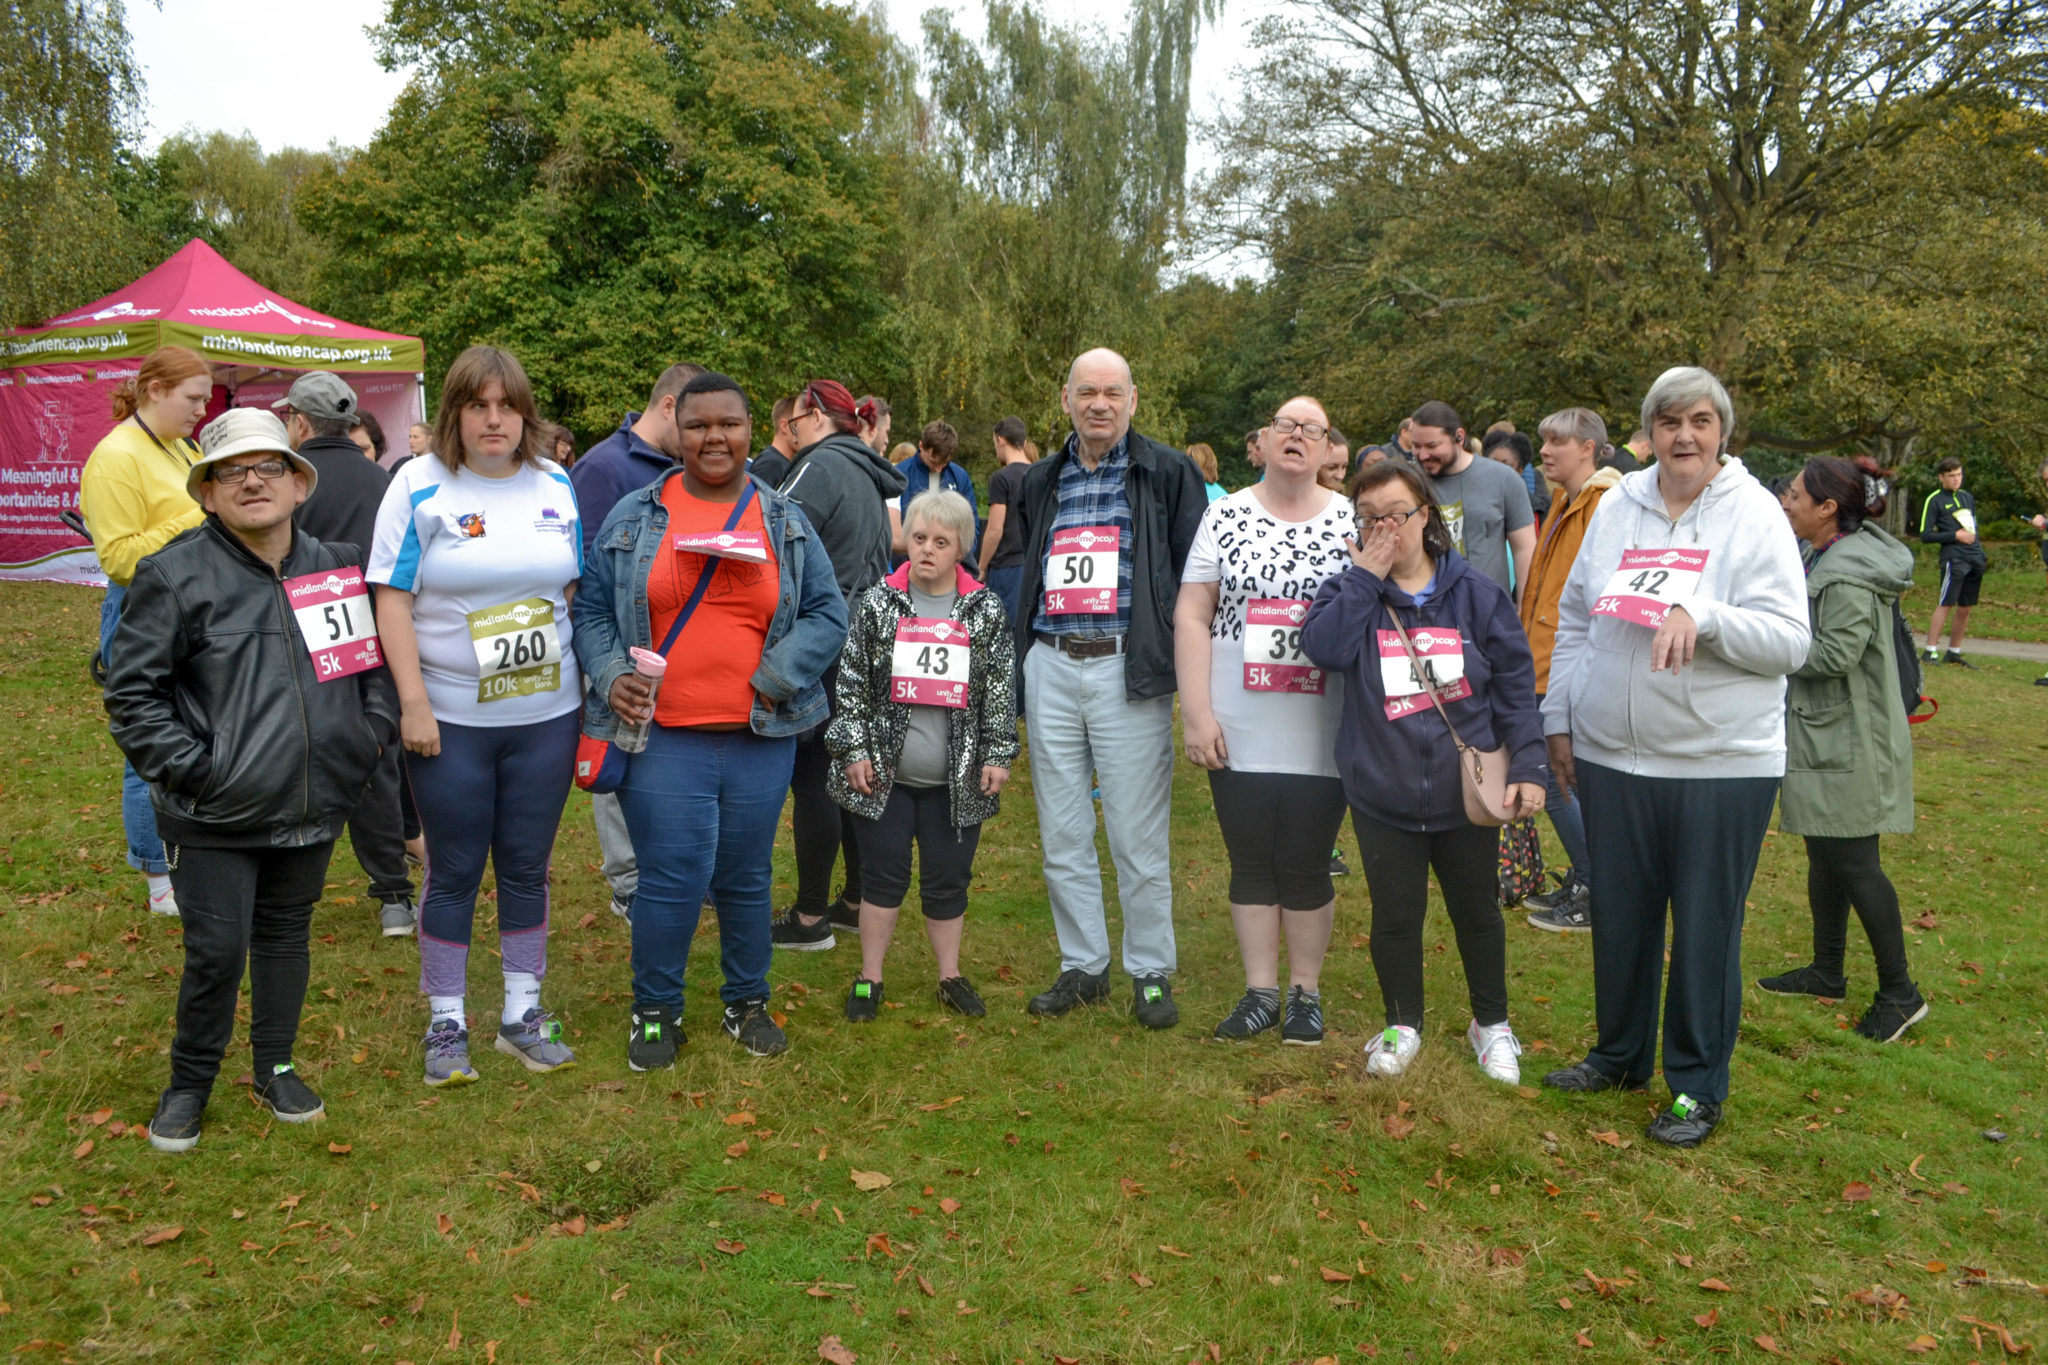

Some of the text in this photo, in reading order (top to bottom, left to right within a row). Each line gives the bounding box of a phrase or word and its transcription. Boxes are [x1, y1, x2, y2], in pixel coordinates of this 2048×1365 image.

[202, 334, 392, 363] midlandmencap.org.uk
[1, 466, 79, 487] Meaningful &
[62, 492, 71, 508] &
[1055, 532, 1115, 547] midlandmencap
[1063, 555, 1094, 584] 50
[1626, 552, 1702, 565] midlandmencap
[291, 576, 362, 598] midlandmencap
[1629, 570, 1669, 596] 42
[1048, 593, 1066, 611] 5k
[1594, 598, 1621, 613] 5k
[324, 603, 354, 641] 51
[473, 605, 550, 628] midlandmencap
[1640, 609, 1661, 620] unity
[494, 630, 546, 670] 260
[1269, 629, 1301, 660] 39
[320, 652, 343, 675] 5k
[916, 646, 949, 675] 43
[1249, 668, 1272, 686] 5k
[1410, 660, 1437, 689] 44
[483, 675, 517, 698] 10k
[895, 681, 918, 699] 5k
